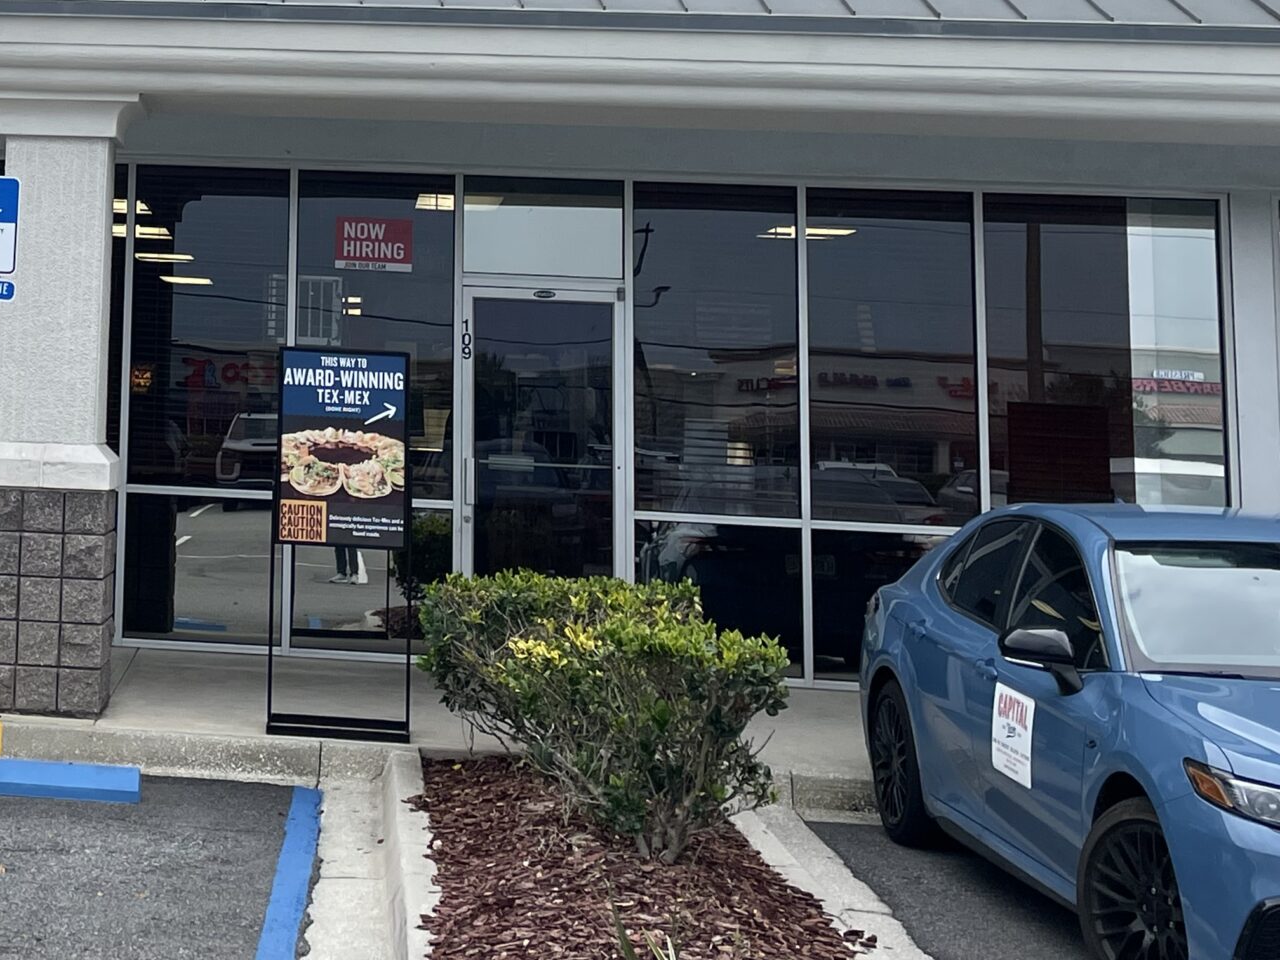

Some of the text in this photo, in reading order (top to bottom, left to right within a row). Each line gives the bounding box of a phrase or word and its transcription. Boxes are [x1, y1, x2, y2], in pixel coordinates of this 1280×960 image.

[343, 221, 386, 240] NOW
[343, 240, 404, 260] HIRING
[462, 319, 472, 360] 109
[321, 356, 367, 368] THIS WAY TO
[283, 367, 404, 390] AWARD-WINNING
[316, 389, 370, 405] TEX-MEX
[281, 503, 322, 517] CAUTION
[281, 515, 322, 529] CAUTION
[280, 527, 322, 540] CAUTION
[997, 692, 1028, 732] CAPITAL
